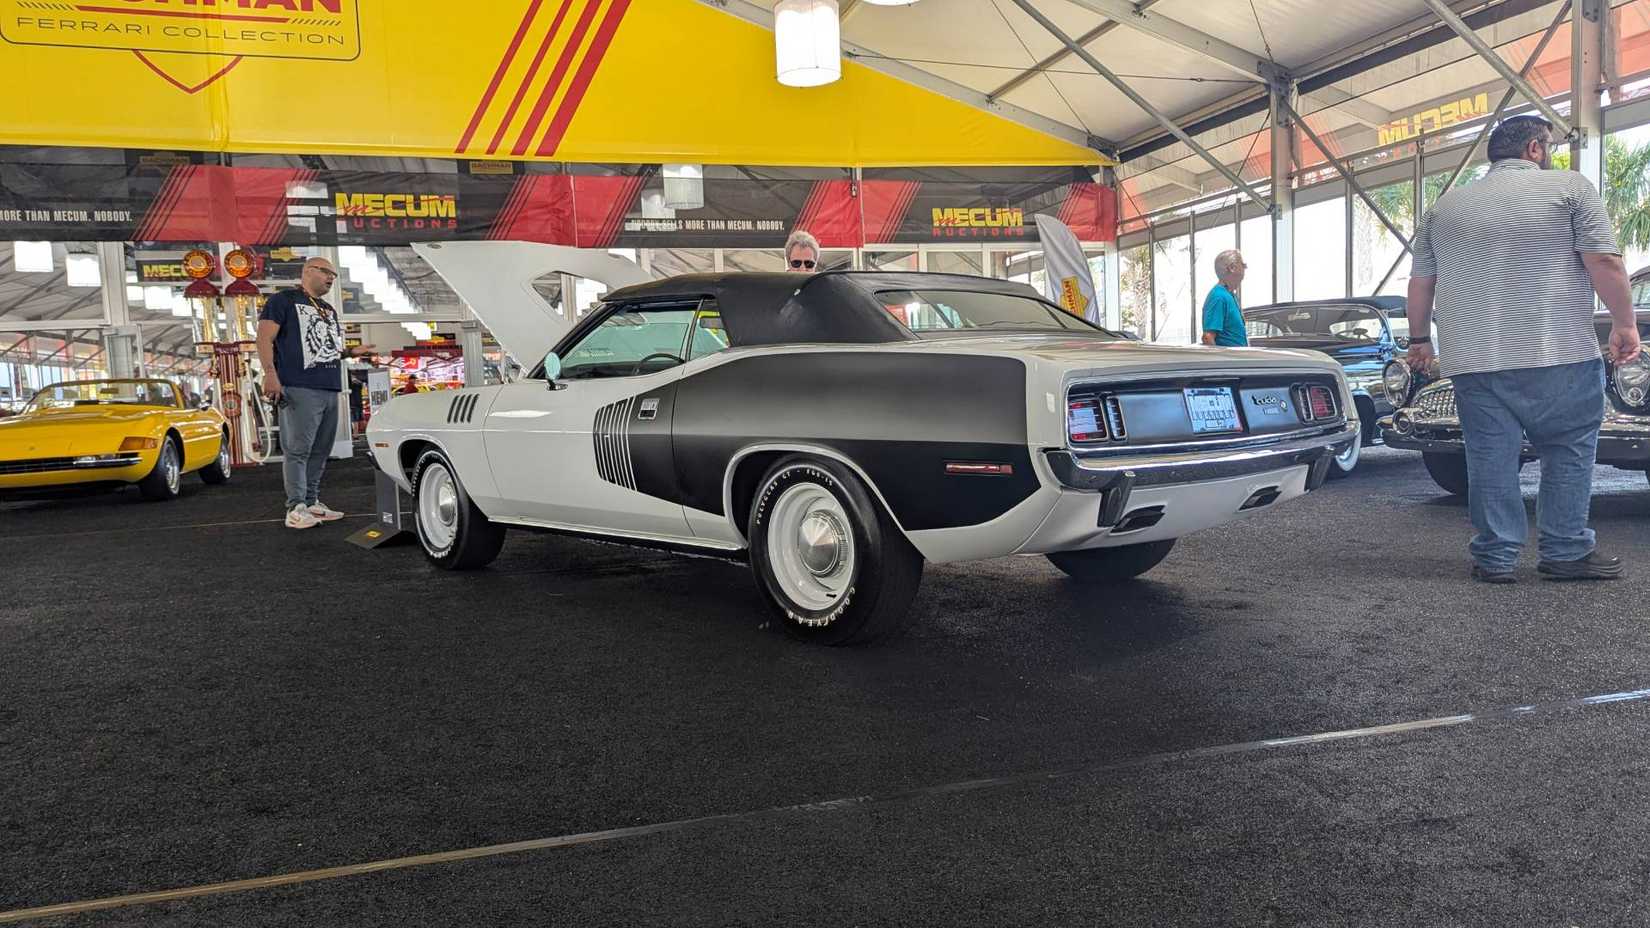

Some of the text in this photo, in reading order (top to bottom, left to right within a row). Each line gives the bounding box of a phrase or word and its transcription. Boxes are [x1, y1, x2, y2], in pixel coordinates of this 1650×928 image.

[17, 17, 345, 45] FERRARI COLLECTION
[335, 192, 457, 217] MECUM
[24, 210, 50, 222] THAN
[53, 210, 91, 222] MECUM.
[94, 210, 133, 222] NOBODY.
[336, 218, 457, 229] UCTIONS
[932, 207, 1024, 227] MECUM
[685, 219, 705, 230] MORE
[707, 219, 725, 231] THAN
